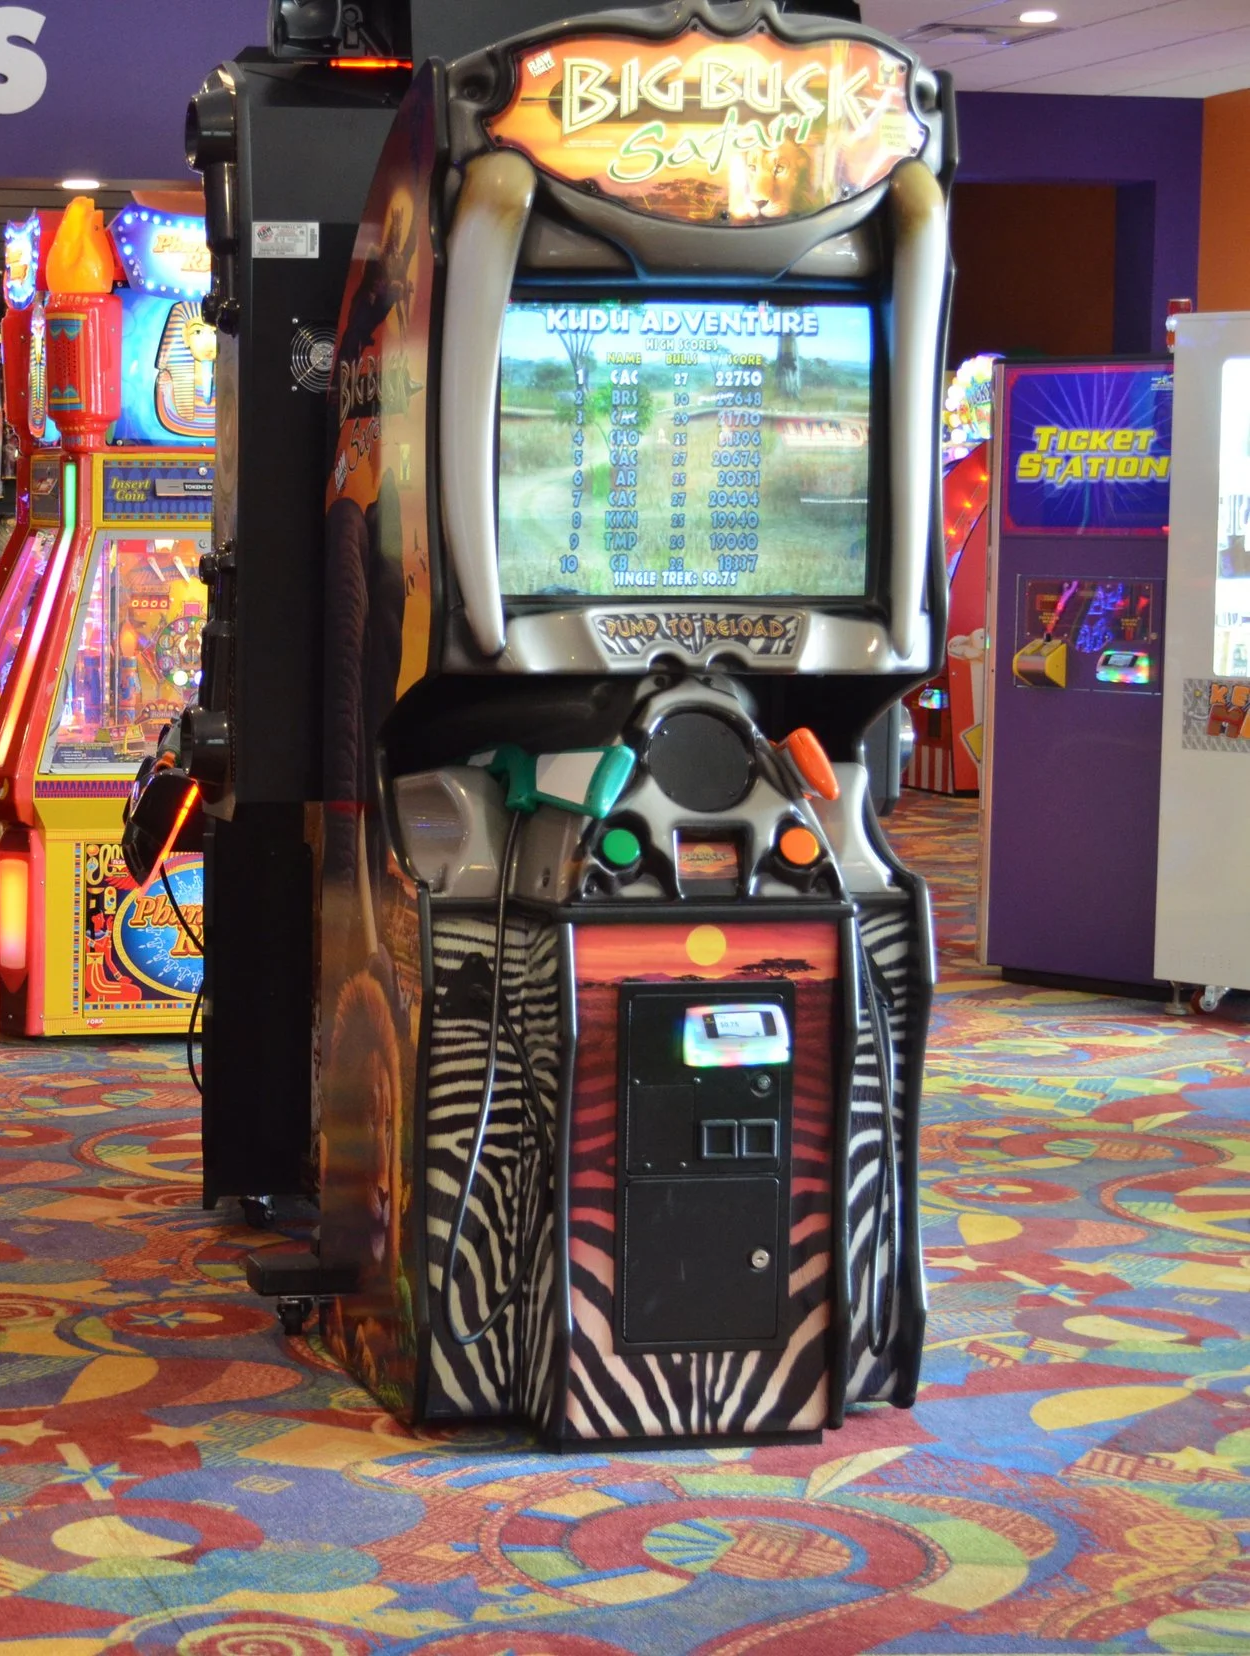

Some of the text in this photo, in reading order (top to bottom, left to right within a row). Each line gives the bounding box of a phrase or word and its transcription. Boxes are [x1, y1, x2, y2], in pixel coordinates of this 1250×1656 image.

[562, 57, 872, 138] BIG BUCK
[607, 108, 821, 184] Safari
[547, 309, 818, 336] KUDU ADVENTURE
[646, 339, 718, 351] HIGH SCORES
[606, 353, 762, 366] NAME BULLS SCORE
[576, 369, 762, 386] 1 CAC 27 22750
[575, 390, 583, 405] 2
[612, 390, 638, 406] BRS
[573, 430, 583, 446] 4
[574, 450, 761, 466] 5 CAC 27 20674
[1016, 453, 1171, 484] STATION
[110, 477, 151, 490] Insert
[573, 470, 583, 486] 6
[115, 489, 147, 502] Coin
[573, 490, 760, 507] 7 CAC 27 20404
[572, 511, 581, 528] 8
[605, 511, 638, 528] KKN
[711, 511, 759, 528] 19940
[570, 533, 579, 550] 9
[604, 532, 637, 550] TMP
[710, 533, 758, 550] 19060
[560, 554, 578, 573] 10
[614, 572, 656, 586] SINGLE
[662, 572, 698, 586] TREK:
[605, 618, 785, 638] PUMP TO RELOAD
